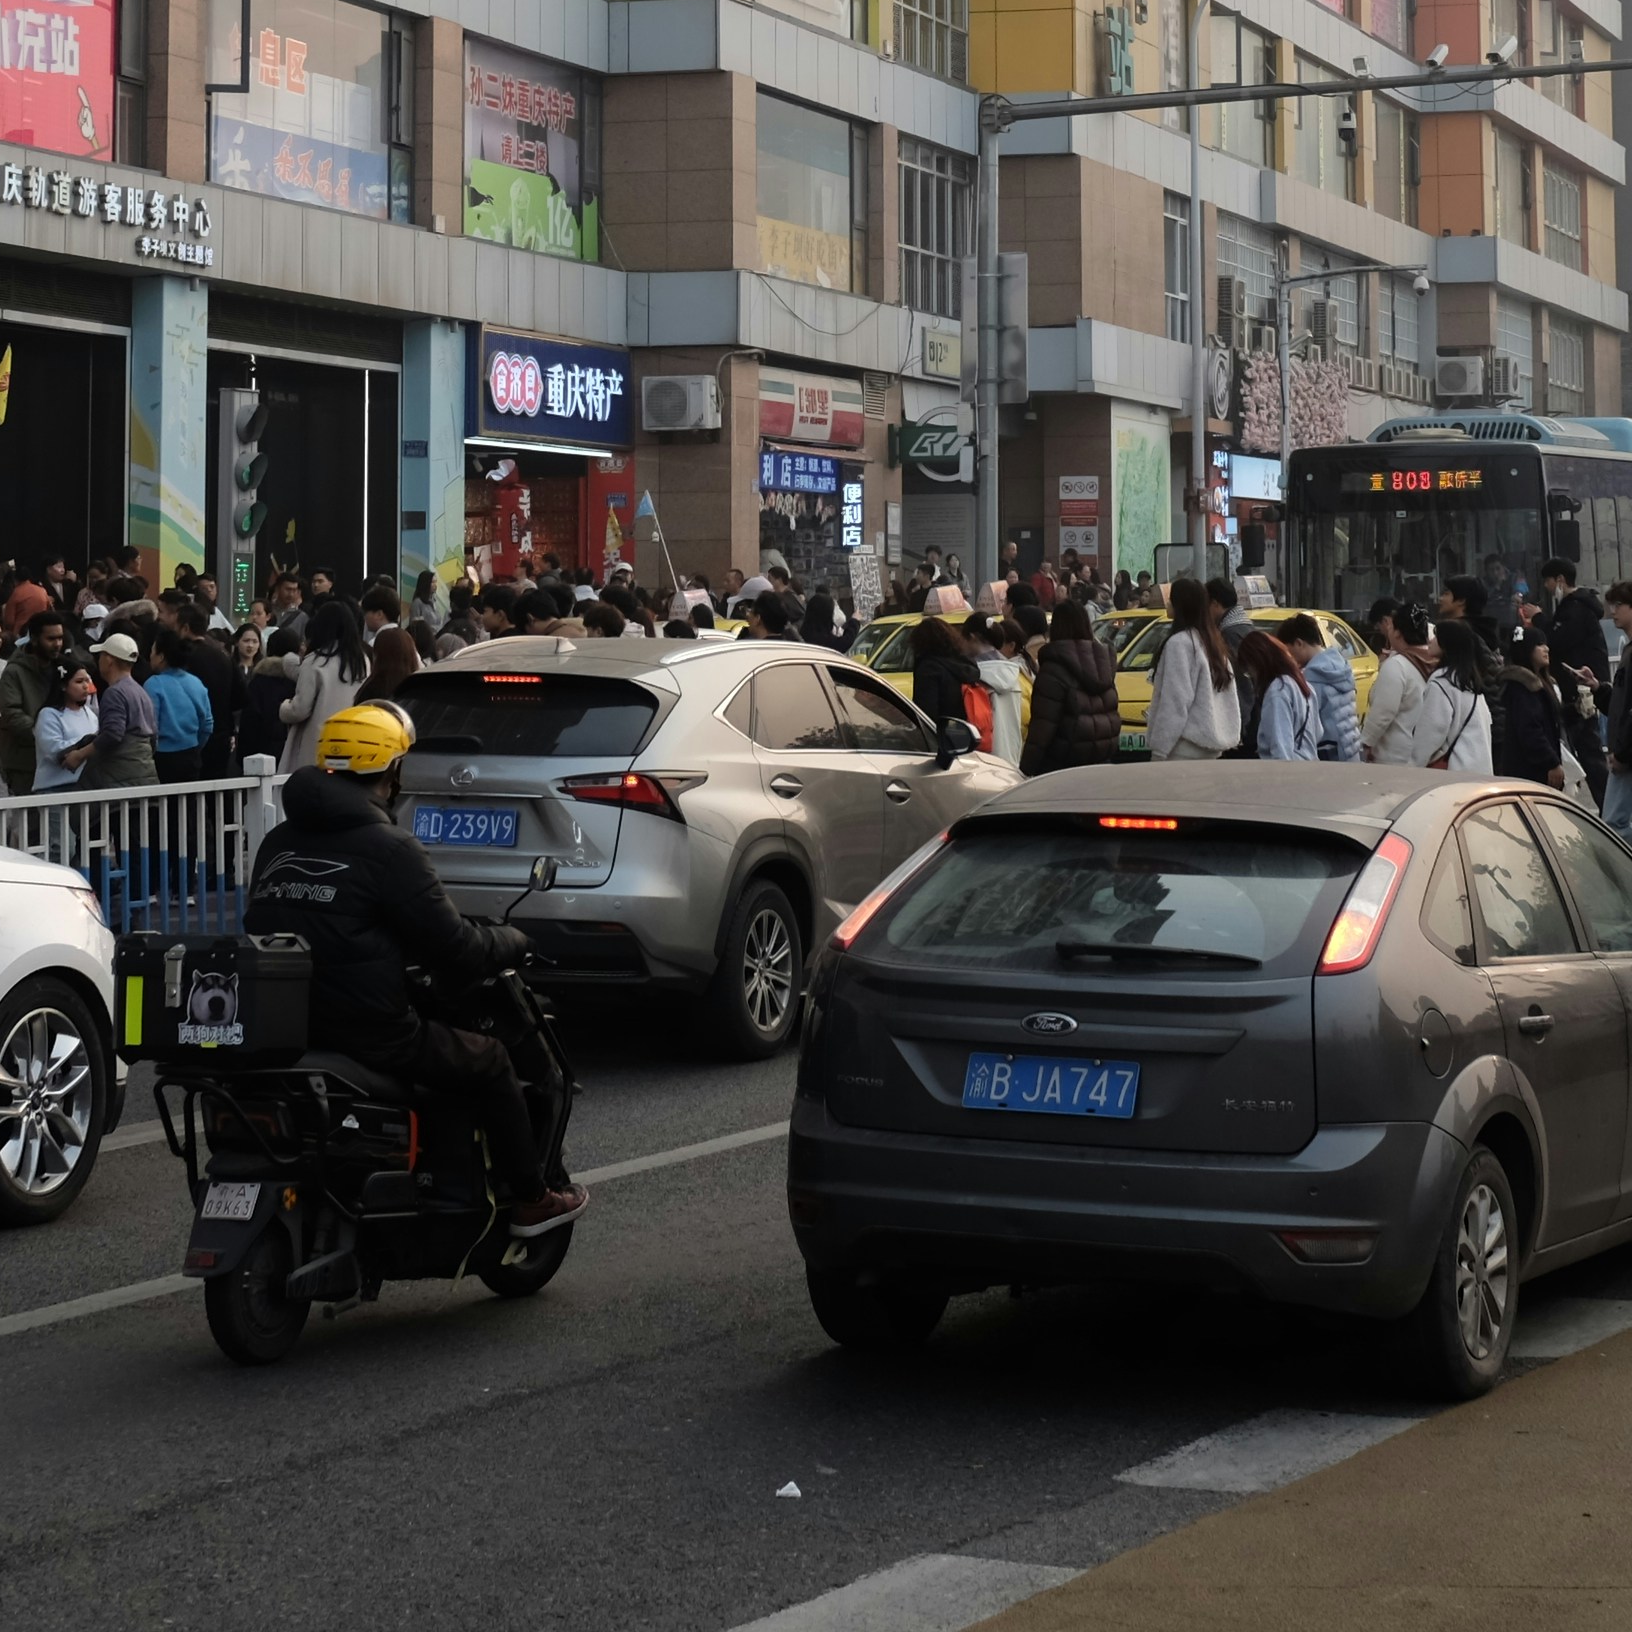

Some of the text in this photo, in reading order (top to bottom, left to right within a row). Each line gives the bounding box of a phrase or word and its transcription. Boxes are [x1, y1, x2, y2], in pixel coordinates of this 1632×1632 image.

[469, 65, 576, 134] 孙二妹重庆特产
[500, 133, 548, 175] 请上二楼
[137, 234, 214, 267] 李子坝文创主题馆
[545, 363, 624, 422] 重庆特产
[841, 482, 863, 547] 便利店
[180, 1023, 244, 1044] 两狗对视
[1032, 1016, 1065, 1032] Ford
[836, 1074, 883, 1088] FOCUS
[1220, 1098, 1296, 1113] 长安福特
[204, 1199, 252, 1216] 09K63
